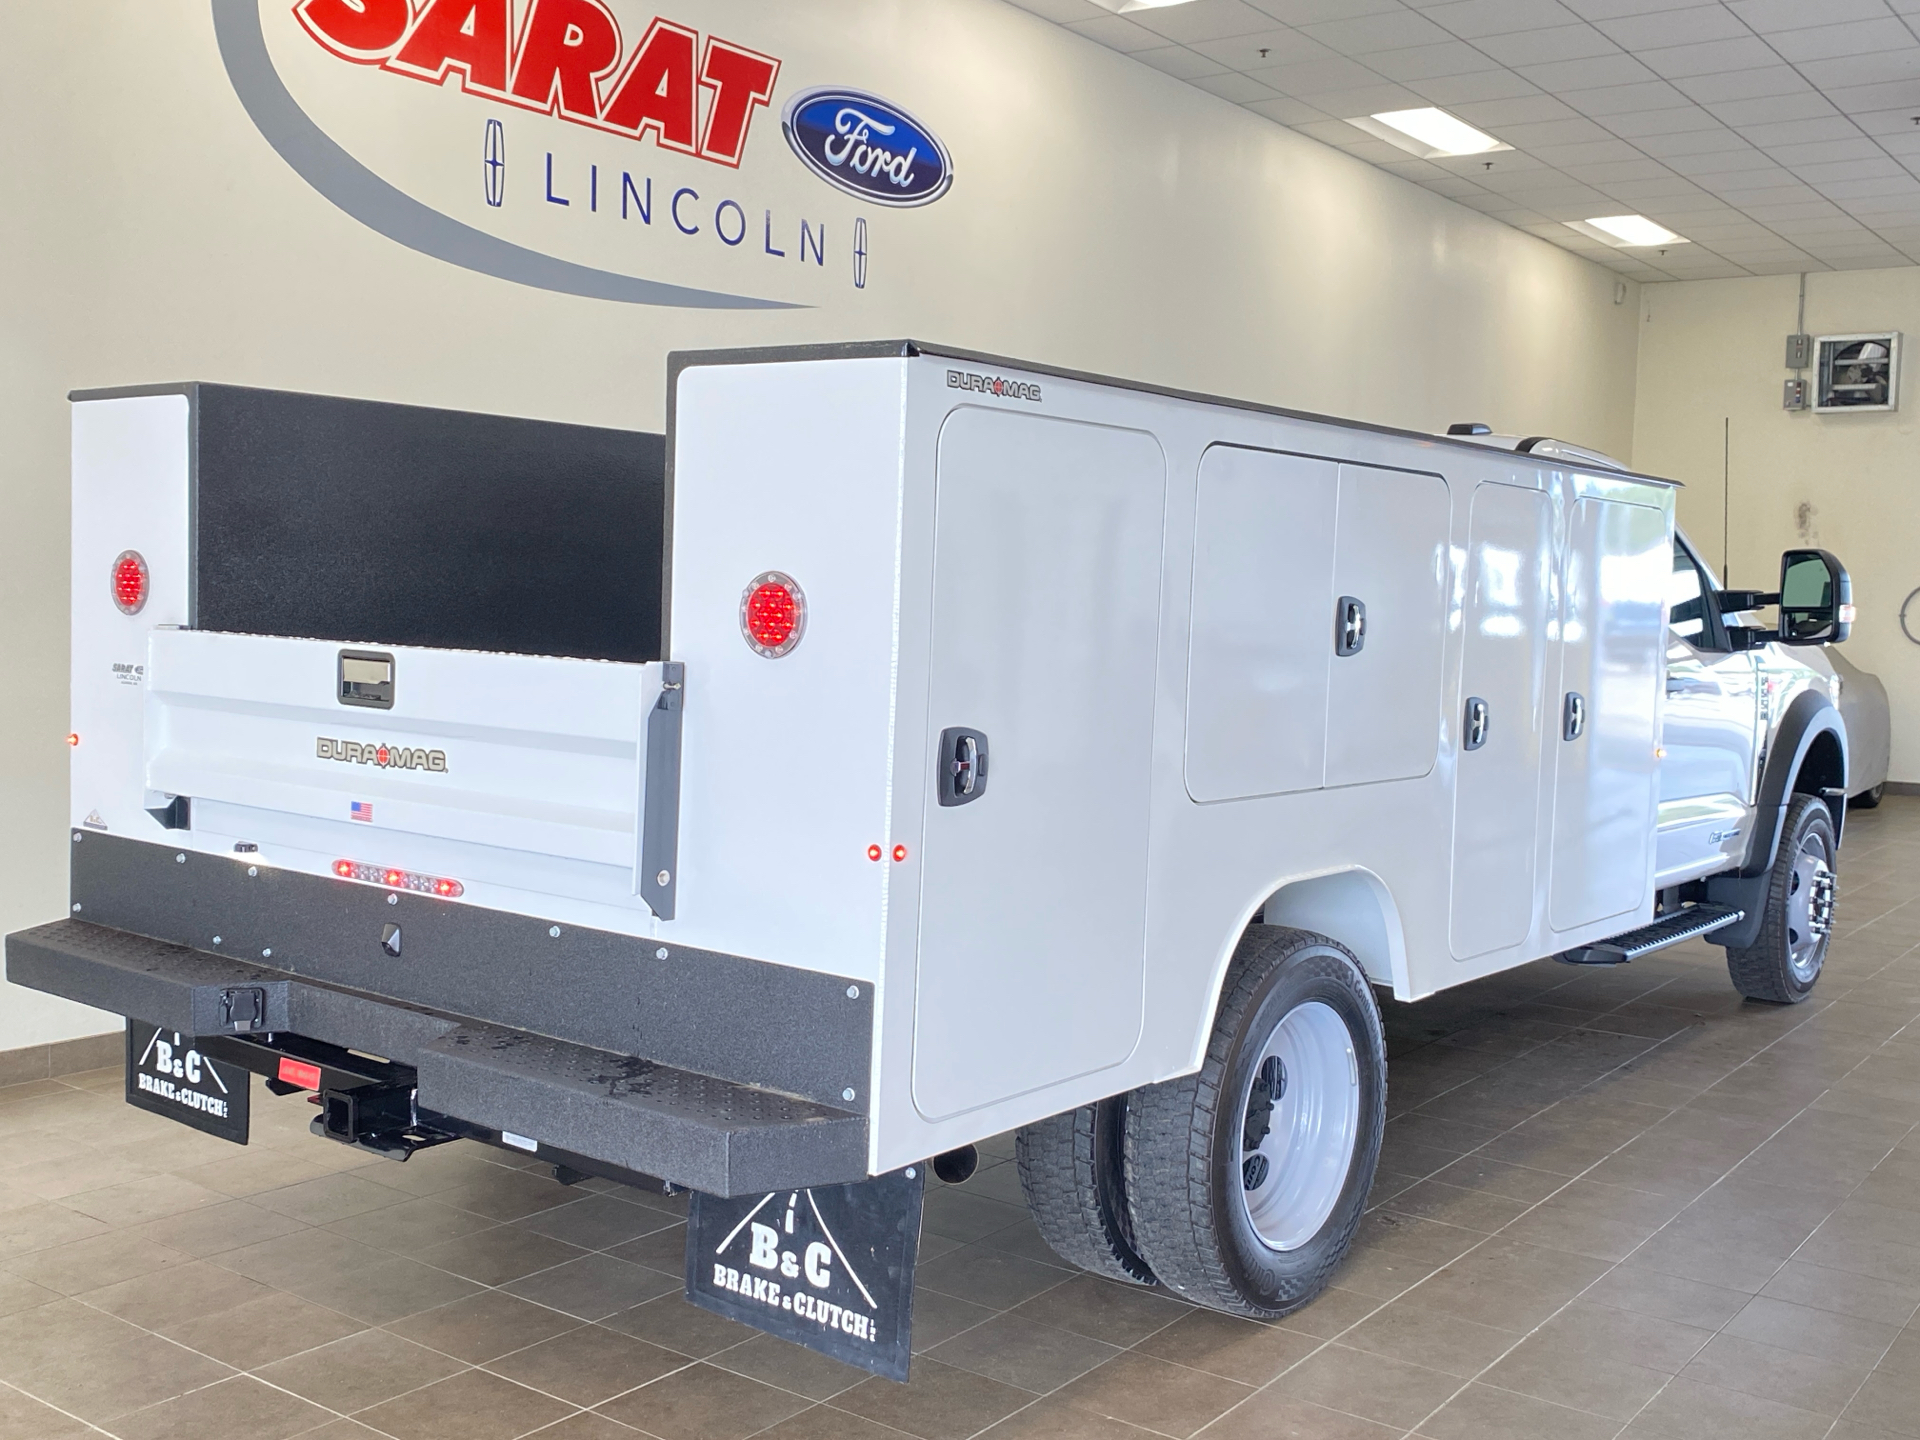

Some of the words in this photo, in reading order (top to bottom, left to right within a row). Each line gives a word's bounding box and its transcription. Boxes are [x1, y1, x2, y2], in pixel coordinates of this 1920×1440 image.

[825, 107, 914, 188] Ford
[545, 152, 825, 267] LINCOLN
[116, 673, 142, 681] LINCOLN
[138, 1072, 175, 1100] BRAKE
[181, 1088, 224, 1117] CLUTCH
[713, 1263, 781, 1307] BRAKE
[793, 1291, 869, 1340] CLUTCH
